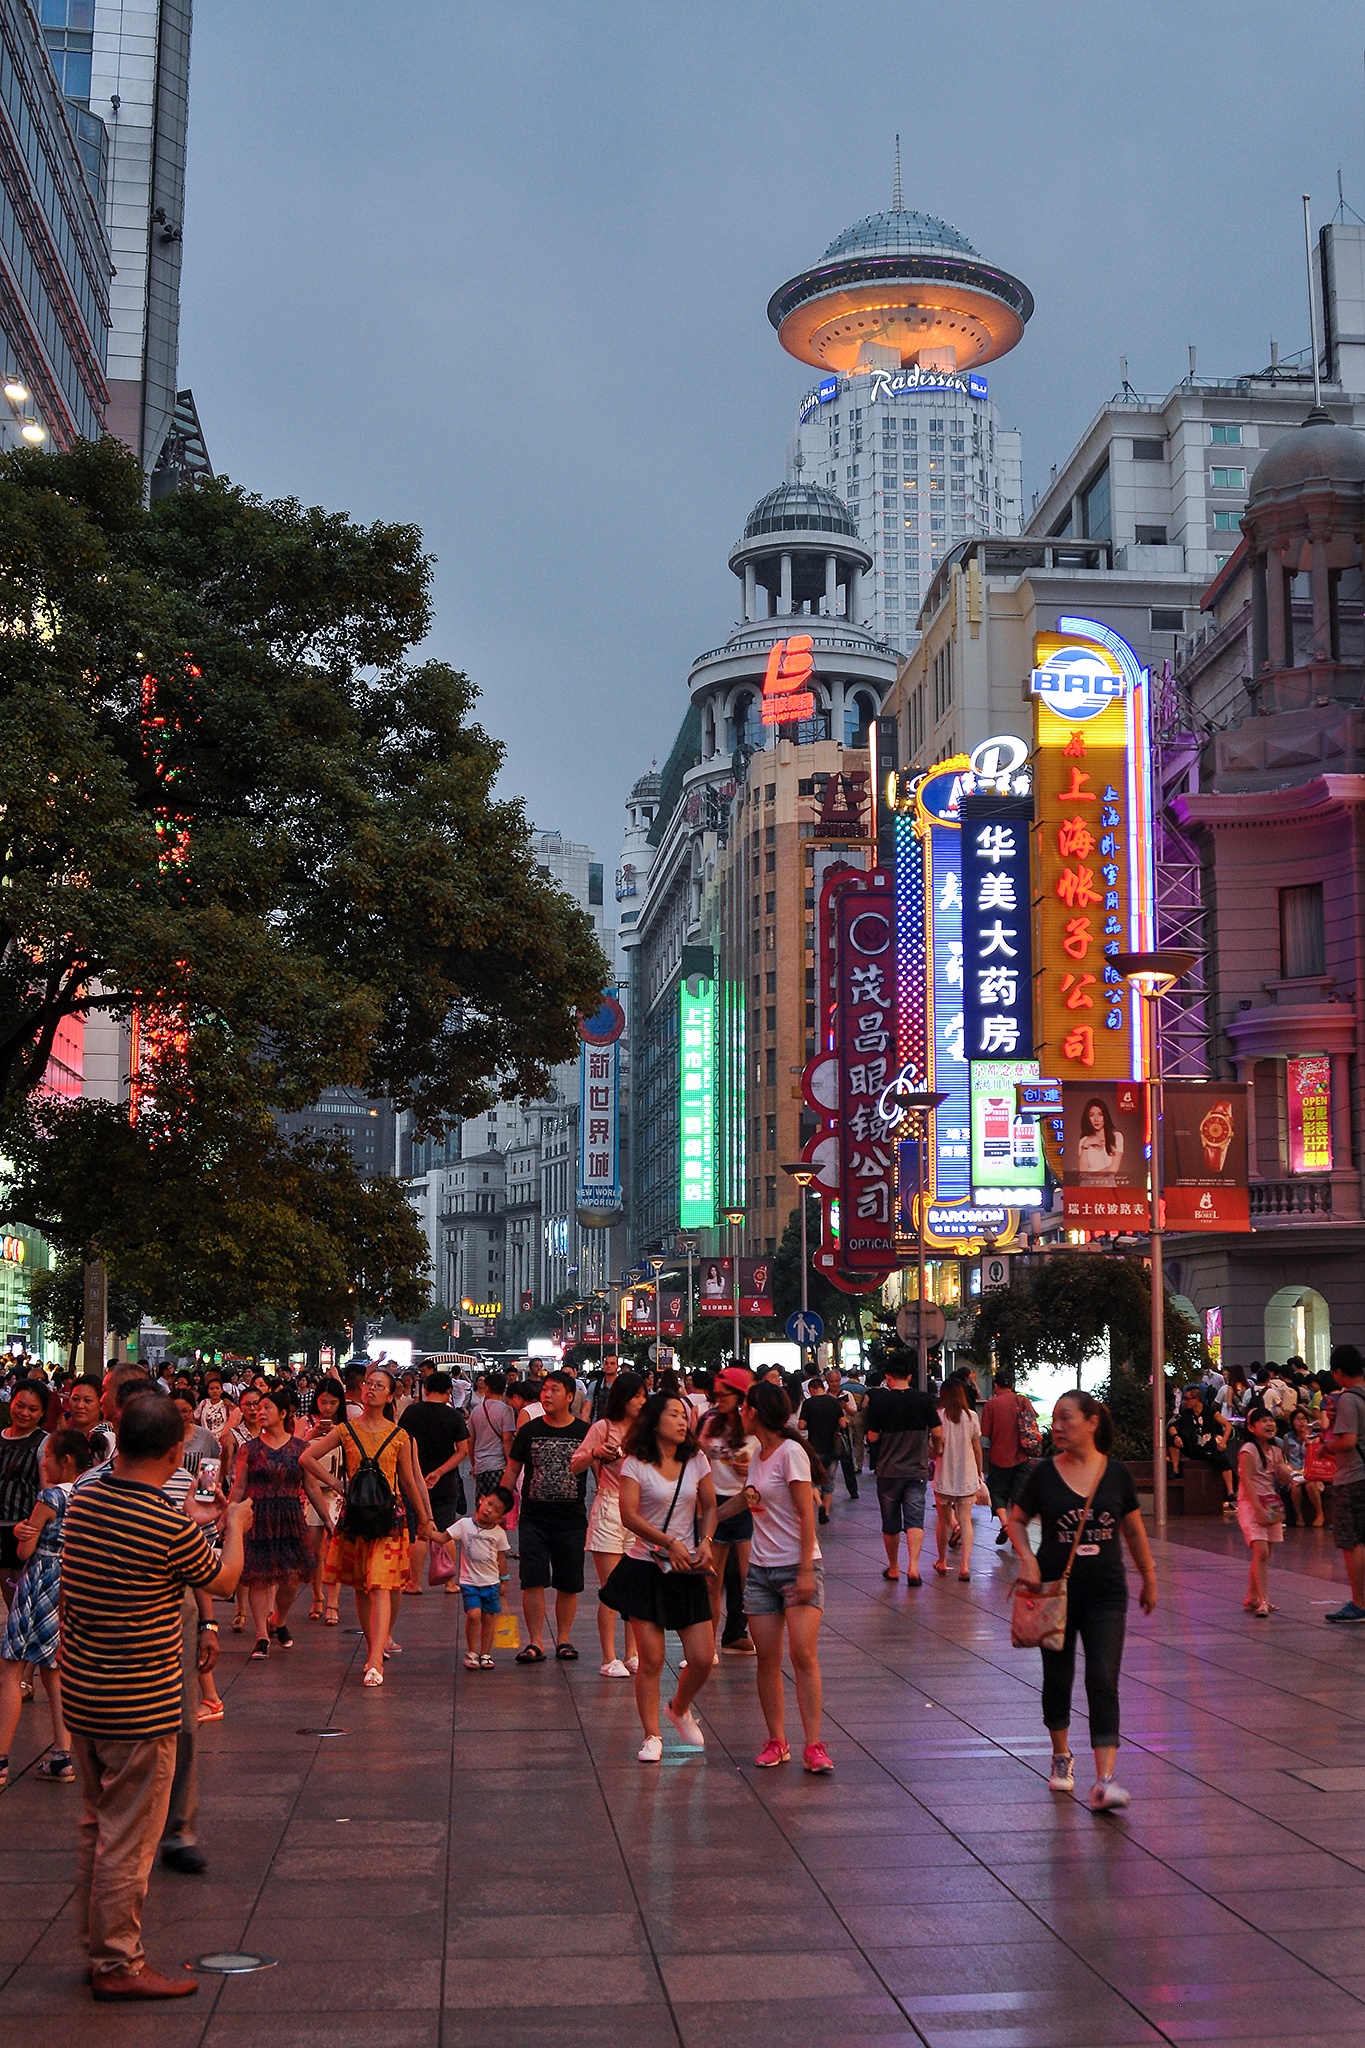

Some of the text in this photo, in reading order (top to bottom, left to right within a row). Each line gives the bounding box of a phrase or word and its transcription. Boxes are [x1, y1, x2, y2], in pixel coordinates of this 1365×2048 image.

[870, 364, 987, 401] Radisson BLU
[820, 385, 836, 396] BLU
[1034, 672, 1120, 695] BAC
[976, 825, 1021, 1053] 华美大药房
[849, 963, 893, 1223] 茂昌眼镜公司
[1024, 1088, 1061, 1102] 创建
[1302, 1096, 1327, 1106] OPEN
[589, 1053, 610, 1177] 新世界城
[929, 1209, 1005, 1223] BAROMON
[1068, 1203, 1145, 1215] 瑞士依波路表
[1194, 1210, 1219, 1219] BOREL
[849, 1238, 895, 1250] OPTICAL
